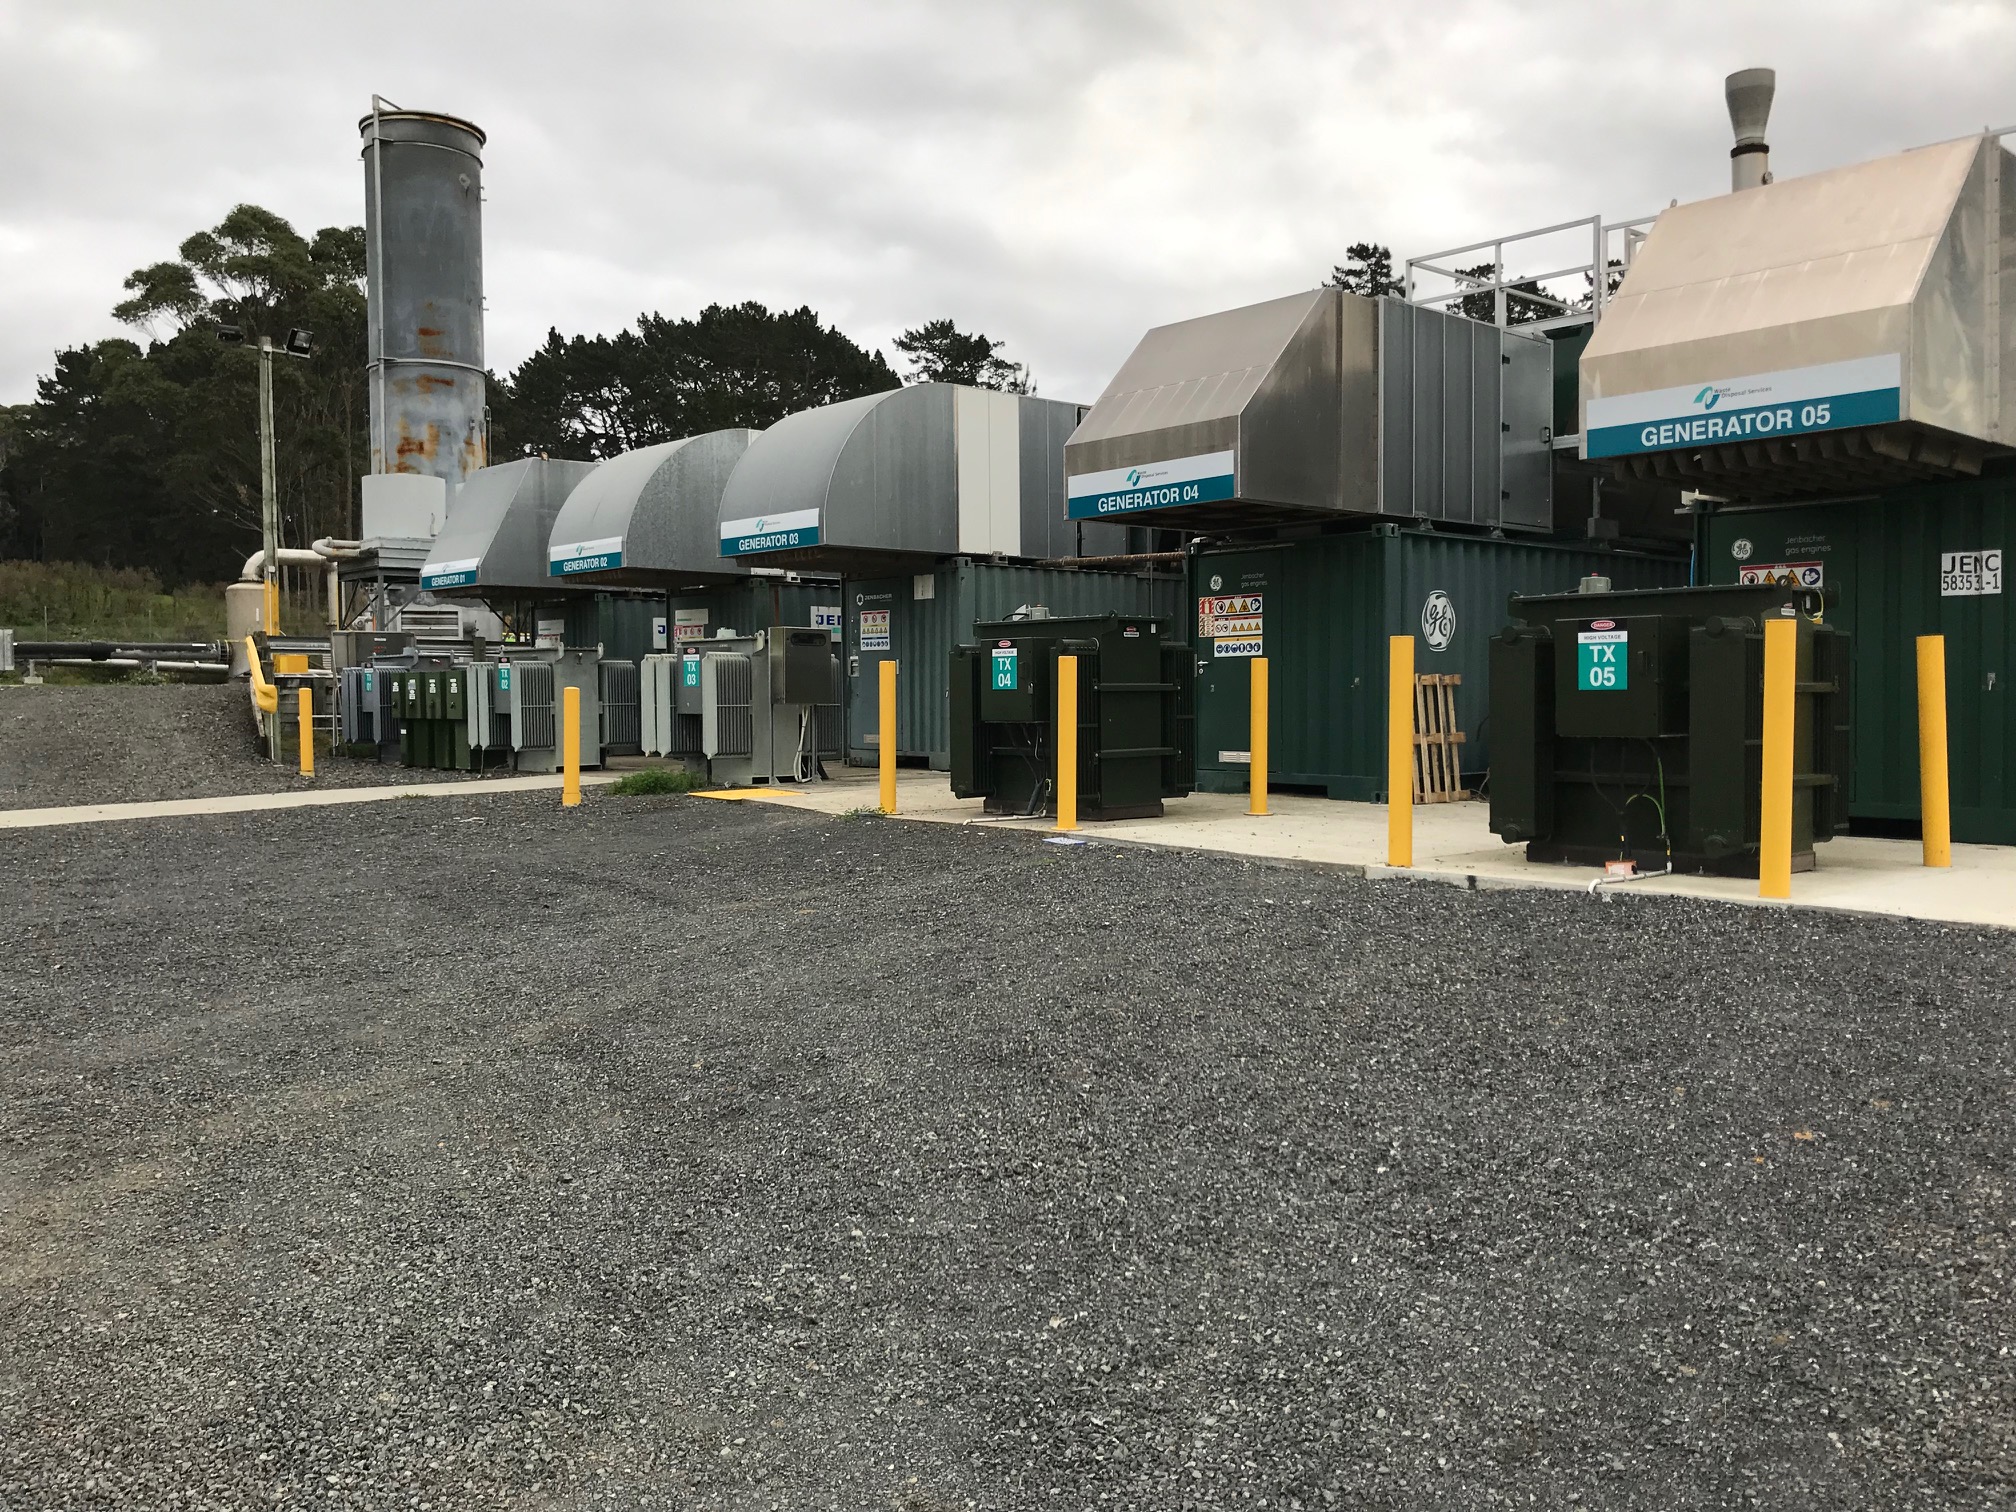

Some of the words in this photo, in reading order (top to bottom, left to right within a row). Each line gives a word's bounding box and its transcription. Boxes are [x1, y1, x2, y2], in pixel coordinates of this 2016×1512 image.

[1721, 390, 1747, 398] Disposal
[1747, 386, 1772, 395] Services
[1641, 409, 1793, 447] GENERATOR
[1801, 404, 1831, 427] 05
[1097, 487, 1180, 513] GENERATOR
[1183, 484, 1199, 501] 04
[738, 533, 787, 551] GENERATOR
[789, 532, 799, 545] 03
[1785, 535, 1826, 545] Jenbacher
[1785, 547, 1799, 556] gas
[1801, 545, 1832, 554] engines
[563, 557, 599, 572] GENERATOR
[600, 556, 608, 568] 02
[1942, 554, 2000, 575] JENC
[431, 574, 459, 587] GENERATOR
[1589, 644, 1616, 663] TX
[686, 661, 697, 672] TX
[997, 657, 1012, 671] TX
[500, 669, 508, 678] TX
[686, 673, 697, 686] 03
[997, 673, 1012, 687] 04
[1589, 666, 1616, 687] 05
[501, 680, 509, 690] 02
